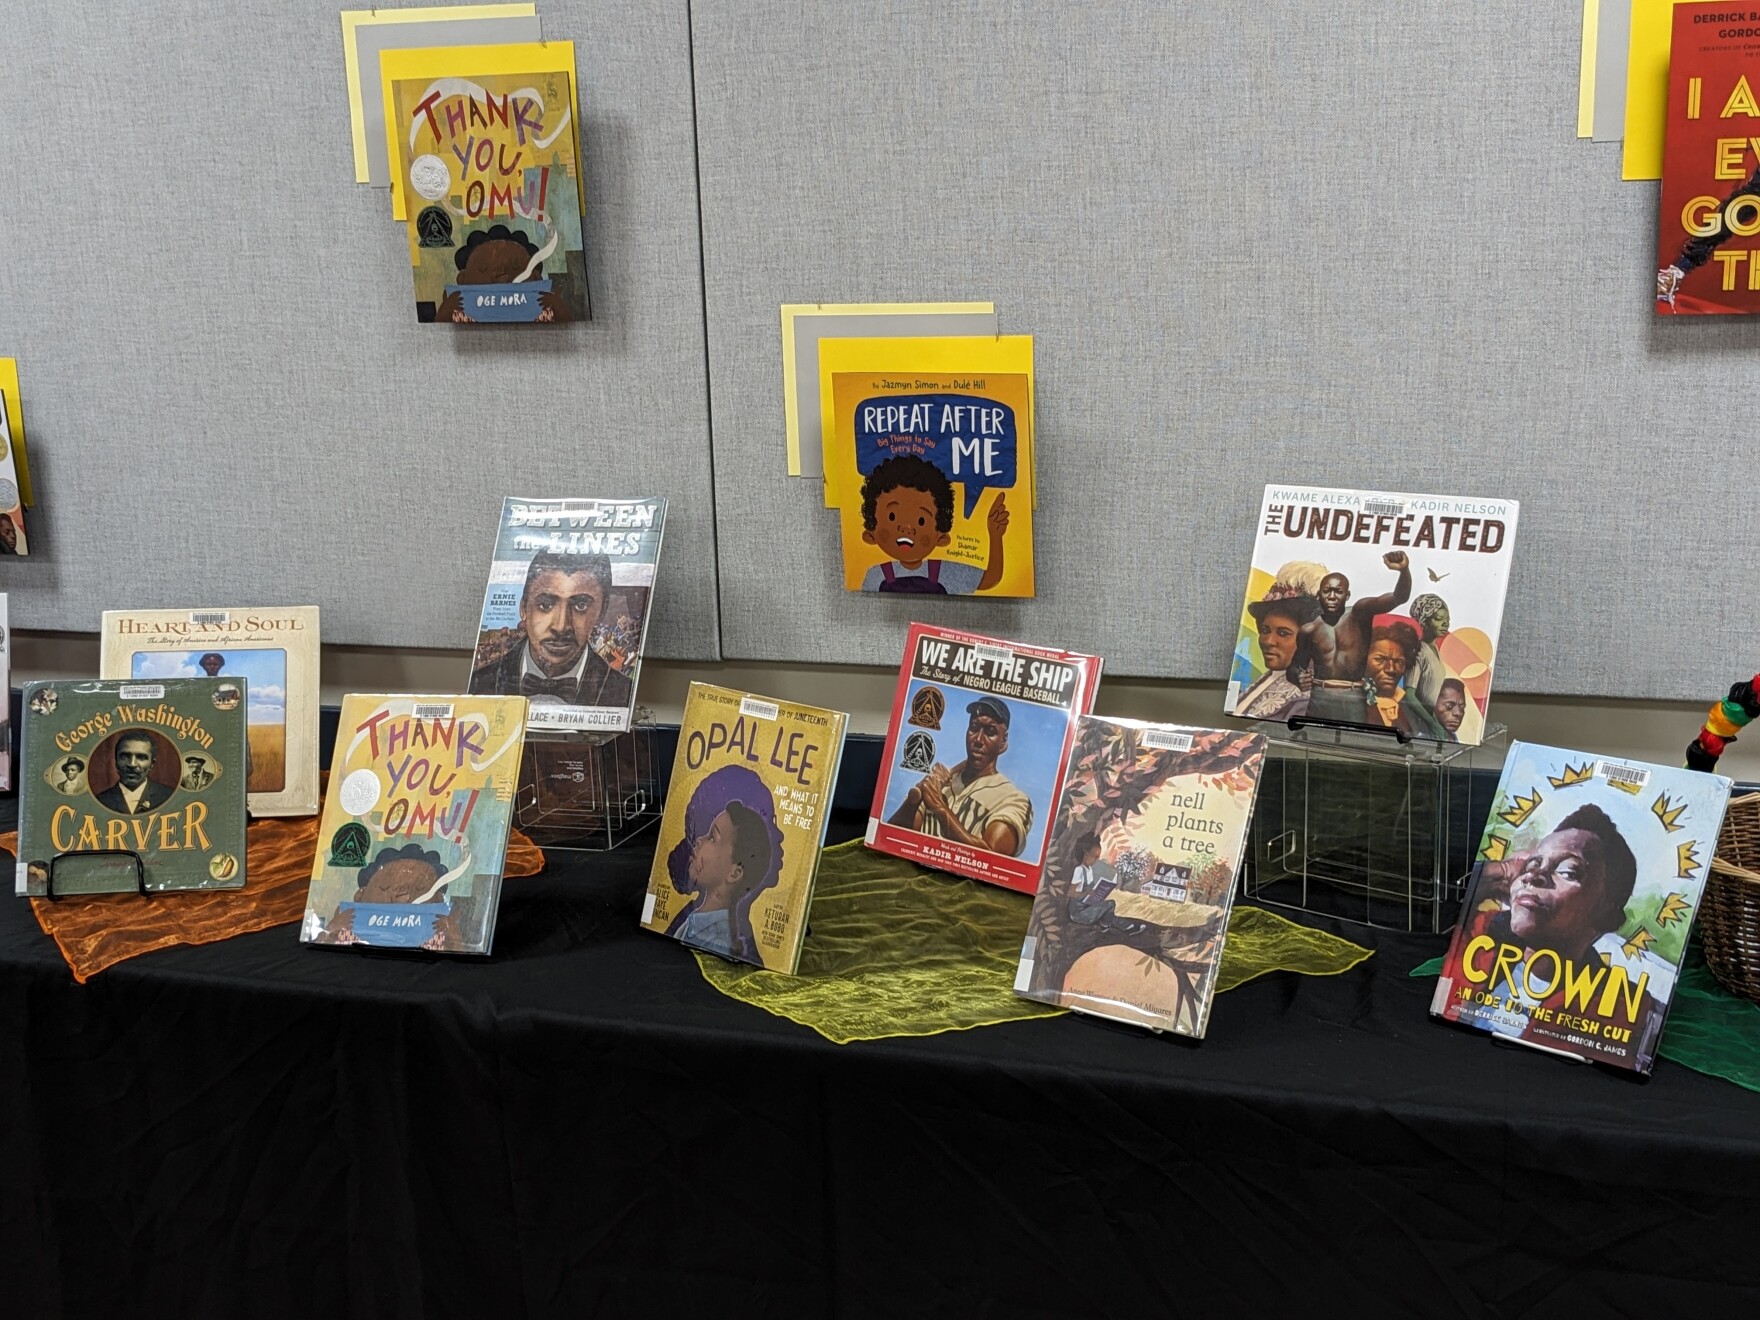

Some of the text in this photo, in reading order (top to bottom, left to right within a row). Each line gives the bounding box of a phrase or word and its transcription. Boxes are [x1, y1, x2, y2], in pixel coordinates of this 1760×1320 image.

[1693, 12, 1746, 24] DERRICK
[1687, 77, 1702, 119] I
[412, 88, 544, 147] THANK
[452, 135, 523, 182] YOU,
[1714, 137, 1760, 180] E
[465, 167, 550, 222] OMU!
[476, 293, 527, 308] OGE MORA
[881, 380, 912, 390] Jazmyn
[914, 380, 939, 390] Simon
[953, 380, 971, 390] Dulé
[973, 379, 986, 390] Hill
[863, 403, 1005, 436] REPEAT AFTER
[889, 434, 912, 444] Things
[915, 434, 922, 443] to
[924, 437, 936, 449] Say
[890, 444, 925, 455] Every Day
[951, 436, 1004, 477] ME
[1272, 490, 1318, 504] KWAME
[1410, 499, 1450, 513] KADIR
[1454, 502, 1507, 516] NELSON
[1263, 503, 1284, 536] THE
[1282, 504, 1506, 554] UNDEFEATED
[547, 531, 641, 556] LINES
[118, 618, 191, 636] HEART
[244, 616, 304, 632] SOUL
[920, 640, 949, 668] WE
[951, 648, 986, 676] ARE
[1027, 661, 1074, 692] SHIP
[919, 665, 1061, 705] The Story of NEGRO LEAGUE BASEBALL
[55, 703, 215, 752] George Washington
[558, 713, 585, 724] BRYAN
[588, 714, 622, 726] COLLIER
[793, 712, 829, 727] JUNETEENTH
[356, 709, 485, 770] THANK
[686, 715, 819, 786] OPAL LEE
[386, 753, 458, 799] YOU,
[773, 784, 819, 805] AND WHAT IT
[1171, 791, 1206, 811] nell
[383, 789, 480, 844] OMU!
[778, 799, 815, 817] MEANS TO
[51, 801, 214, 853] CARVER
[783, 814, 813, 831] BE FREE
[1165, 811, 1224, 835] plants
[1162, 832, 1216, 855] a tree
[922, 845, 989, 870] KADIR NELSON
[368, 914, 422, 928] OGE MORA
[1462, 934, 1649, 1024] CROWN
[1454, 986, 1633, 1044] AN ODE TO THE FRESH CUT
[1474, 1009, 1501, 1022] DERRICK
[1567, 1034, 1595, 1048] GORDON
[1595, 1041, 1602, 1051] C.
[1603, 1044, 1627, 1057] JAMES
